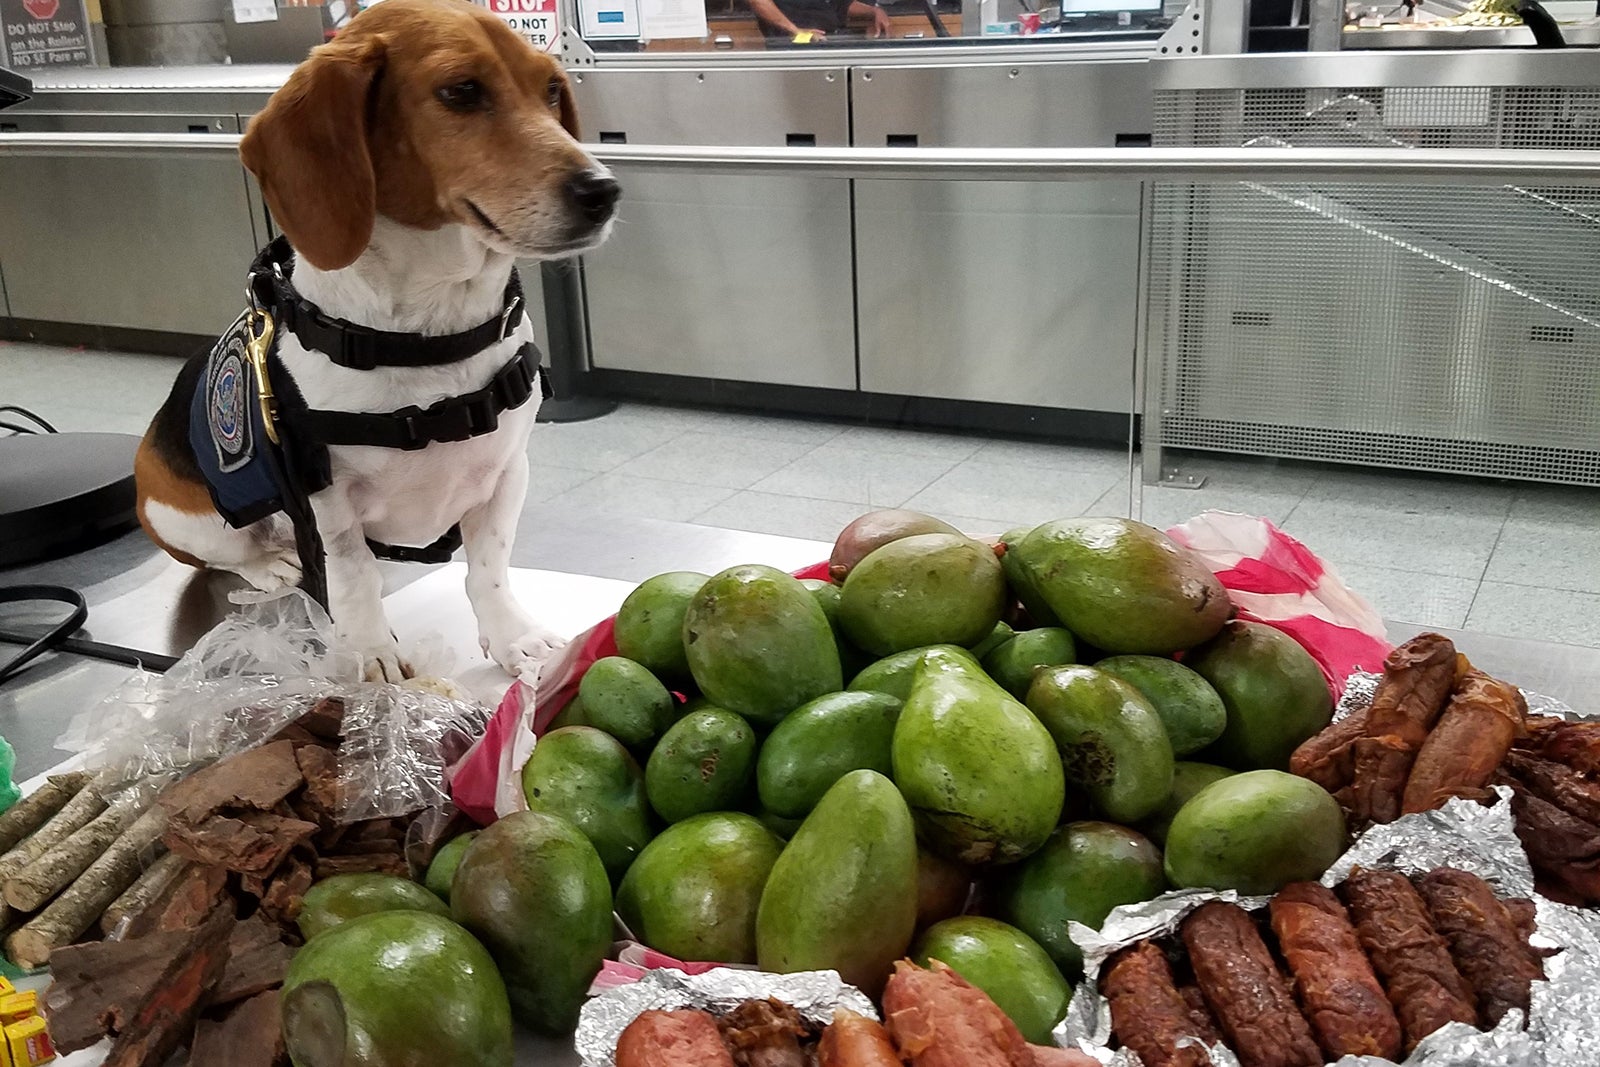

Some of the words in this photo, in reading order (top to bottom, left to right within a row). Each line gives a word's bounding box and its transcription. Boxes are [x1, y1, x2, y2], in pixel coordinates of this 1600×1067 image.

[7, 24, 26, 36] DO
[28, 22, 50, 34] NOT
[521, 18, 547, 29] NOT
[13, 54, 31, 66] NO
